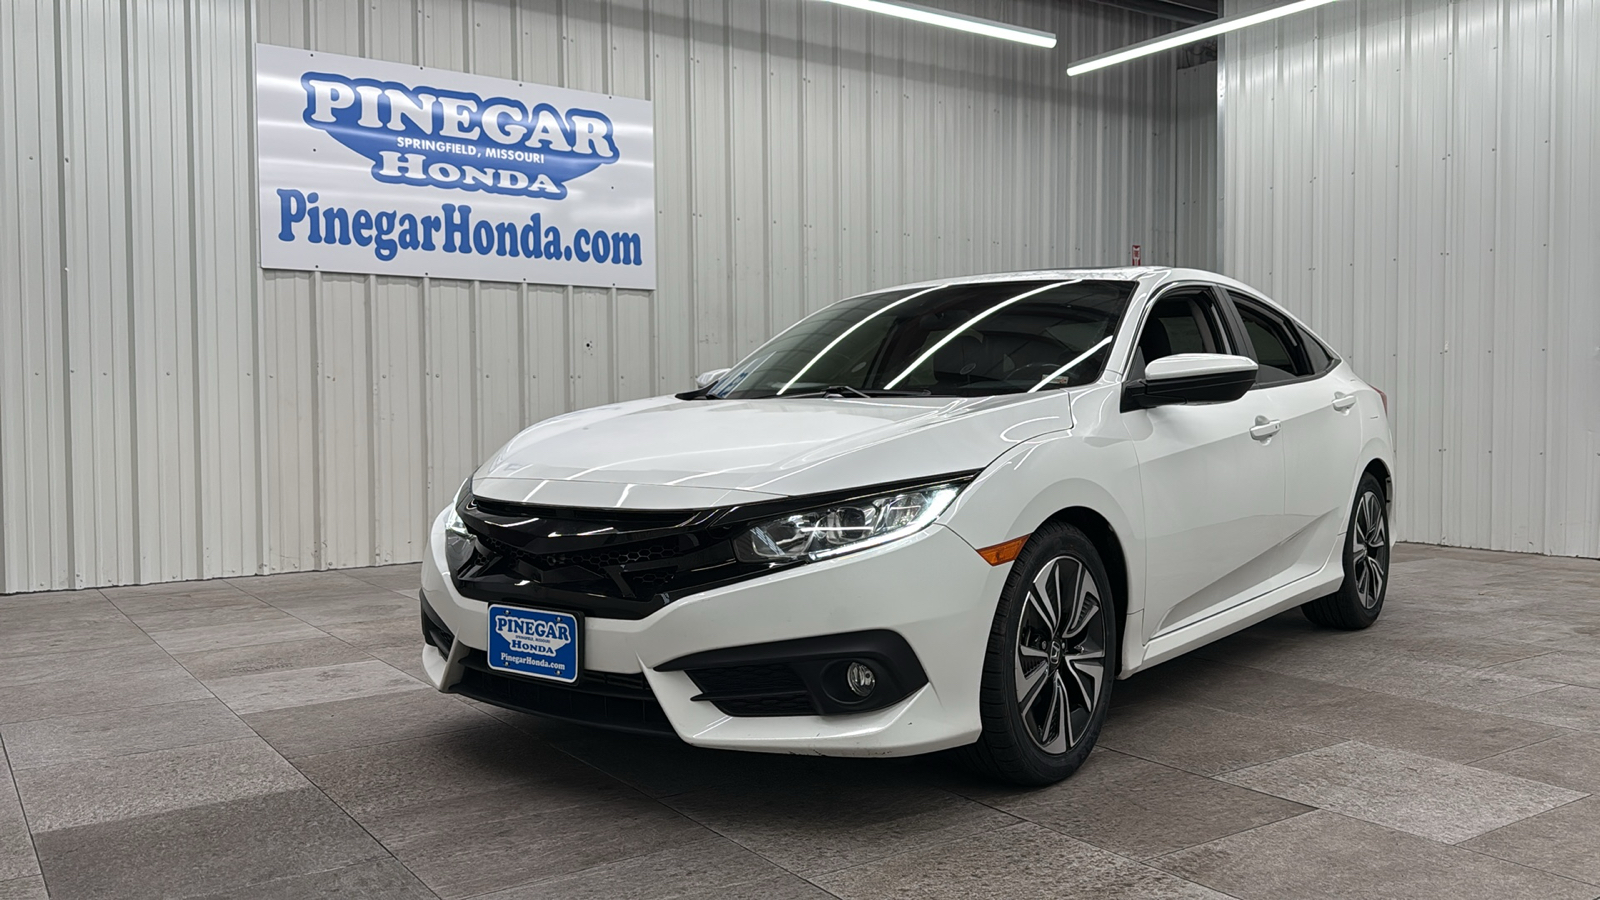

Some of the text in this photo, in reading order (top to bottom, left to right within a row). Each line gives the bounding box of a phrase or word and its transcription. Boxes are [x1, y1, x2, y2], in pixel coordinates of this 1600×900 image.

[308, 79, 614, 158] PINEGAR
[397, 136, 545, 164] SPRINGFIELD, MISSOURI
[378, 151, 562, 194] HONDA
[276, 188, 643, 266] PinegarHonda.com
[497, 617, 569, 641] PINEGAR
[511, 639, 555, 654] HONDA
[500, 652, 566, 670] PinegarHonda.com
